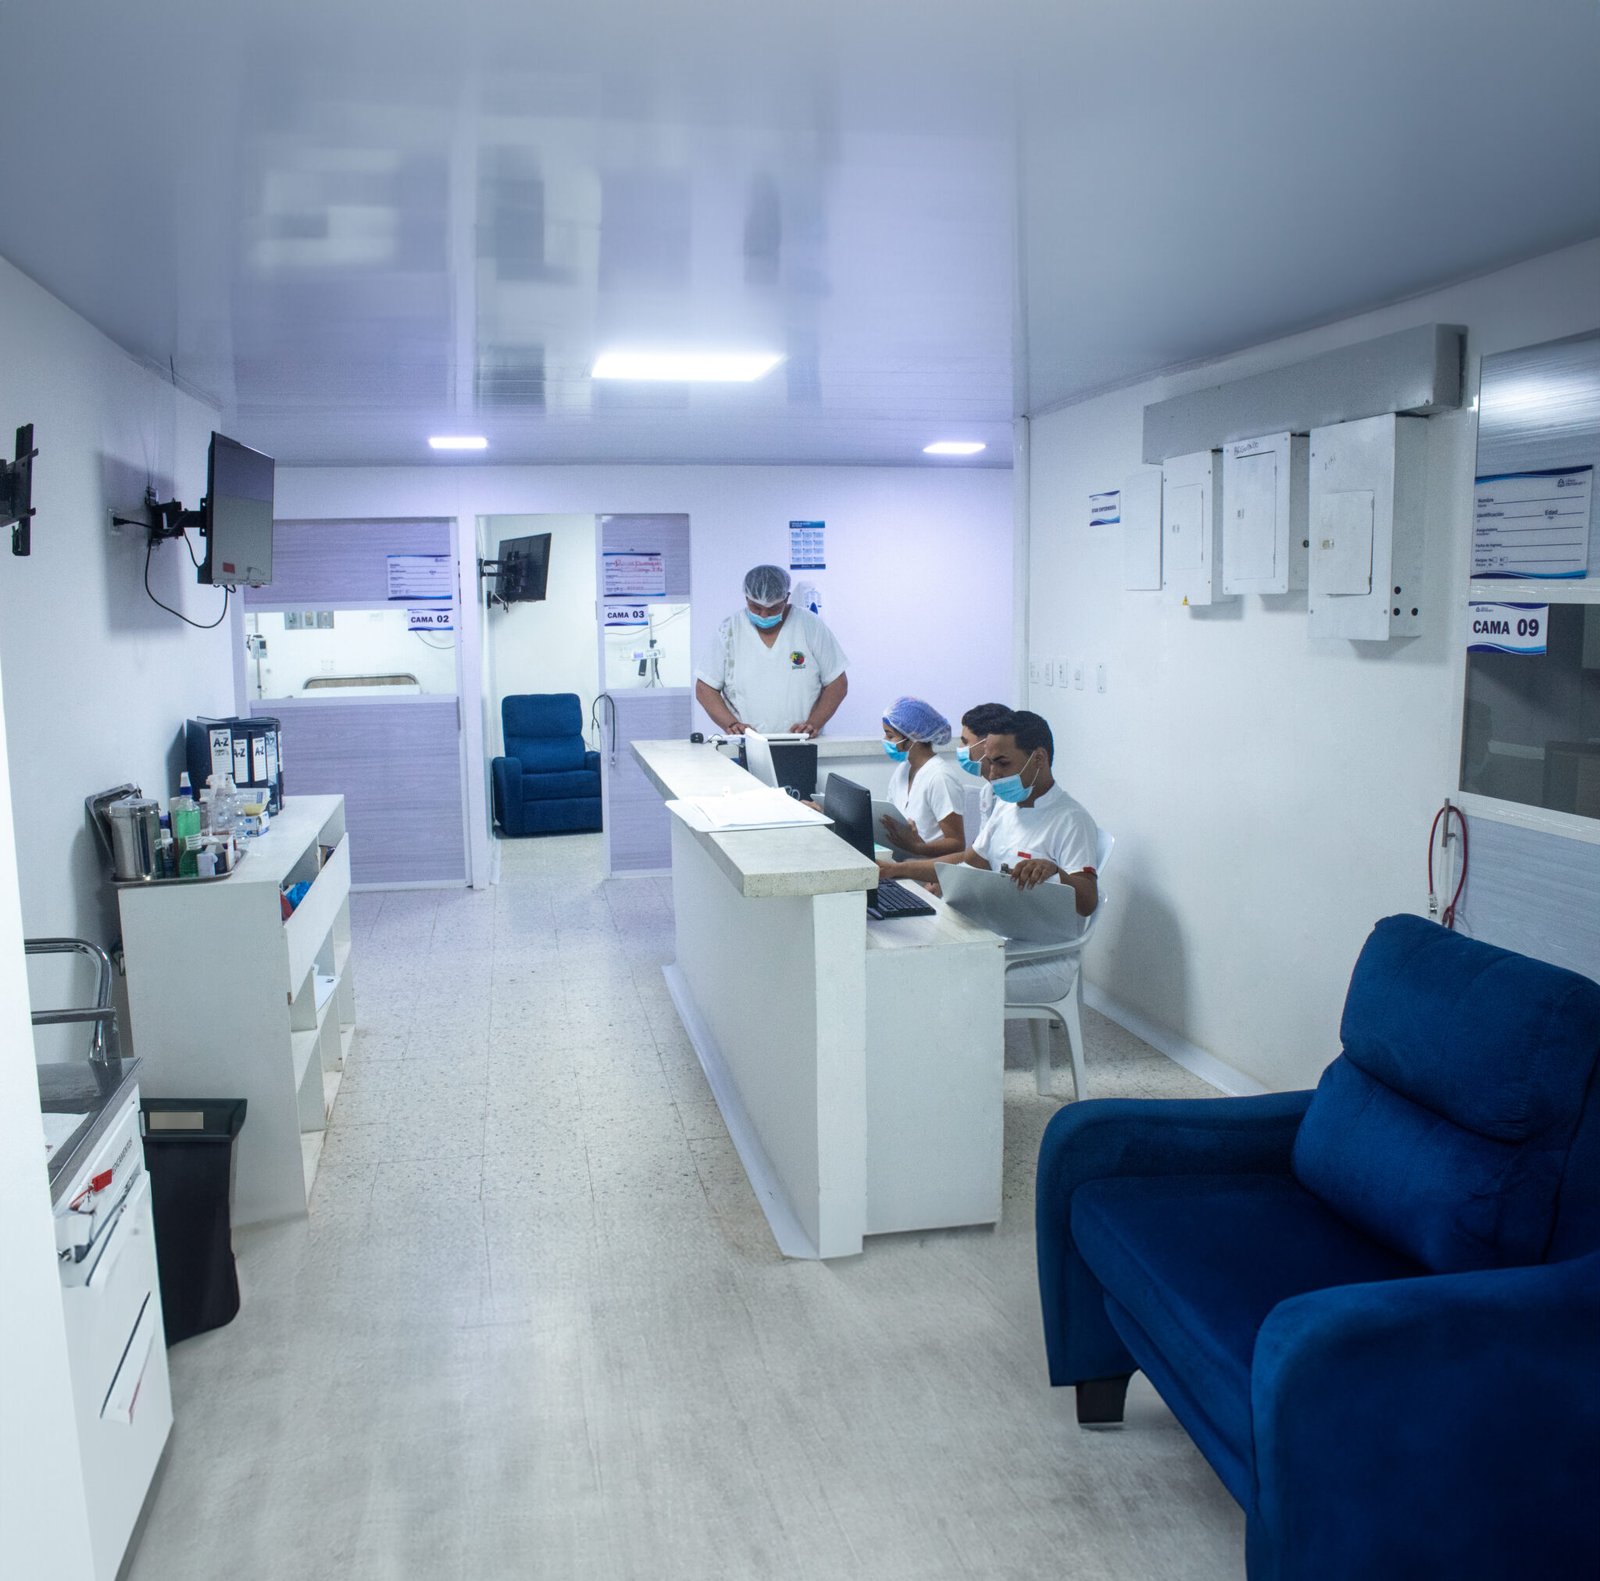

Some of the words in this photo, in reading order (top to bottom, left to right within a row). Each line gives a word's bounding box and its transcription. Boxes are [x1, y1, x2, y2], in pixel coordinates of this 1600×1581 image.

[437, 615, 449, 623] 02
[1473, 620, 1510, 635] CAMA
[1517, 618, 1539, 637] 09
[213, 737, 229, 747] A-Z
[233, 748, 246, 758] A-Z
[255, 745, 265, 757] A-Z
